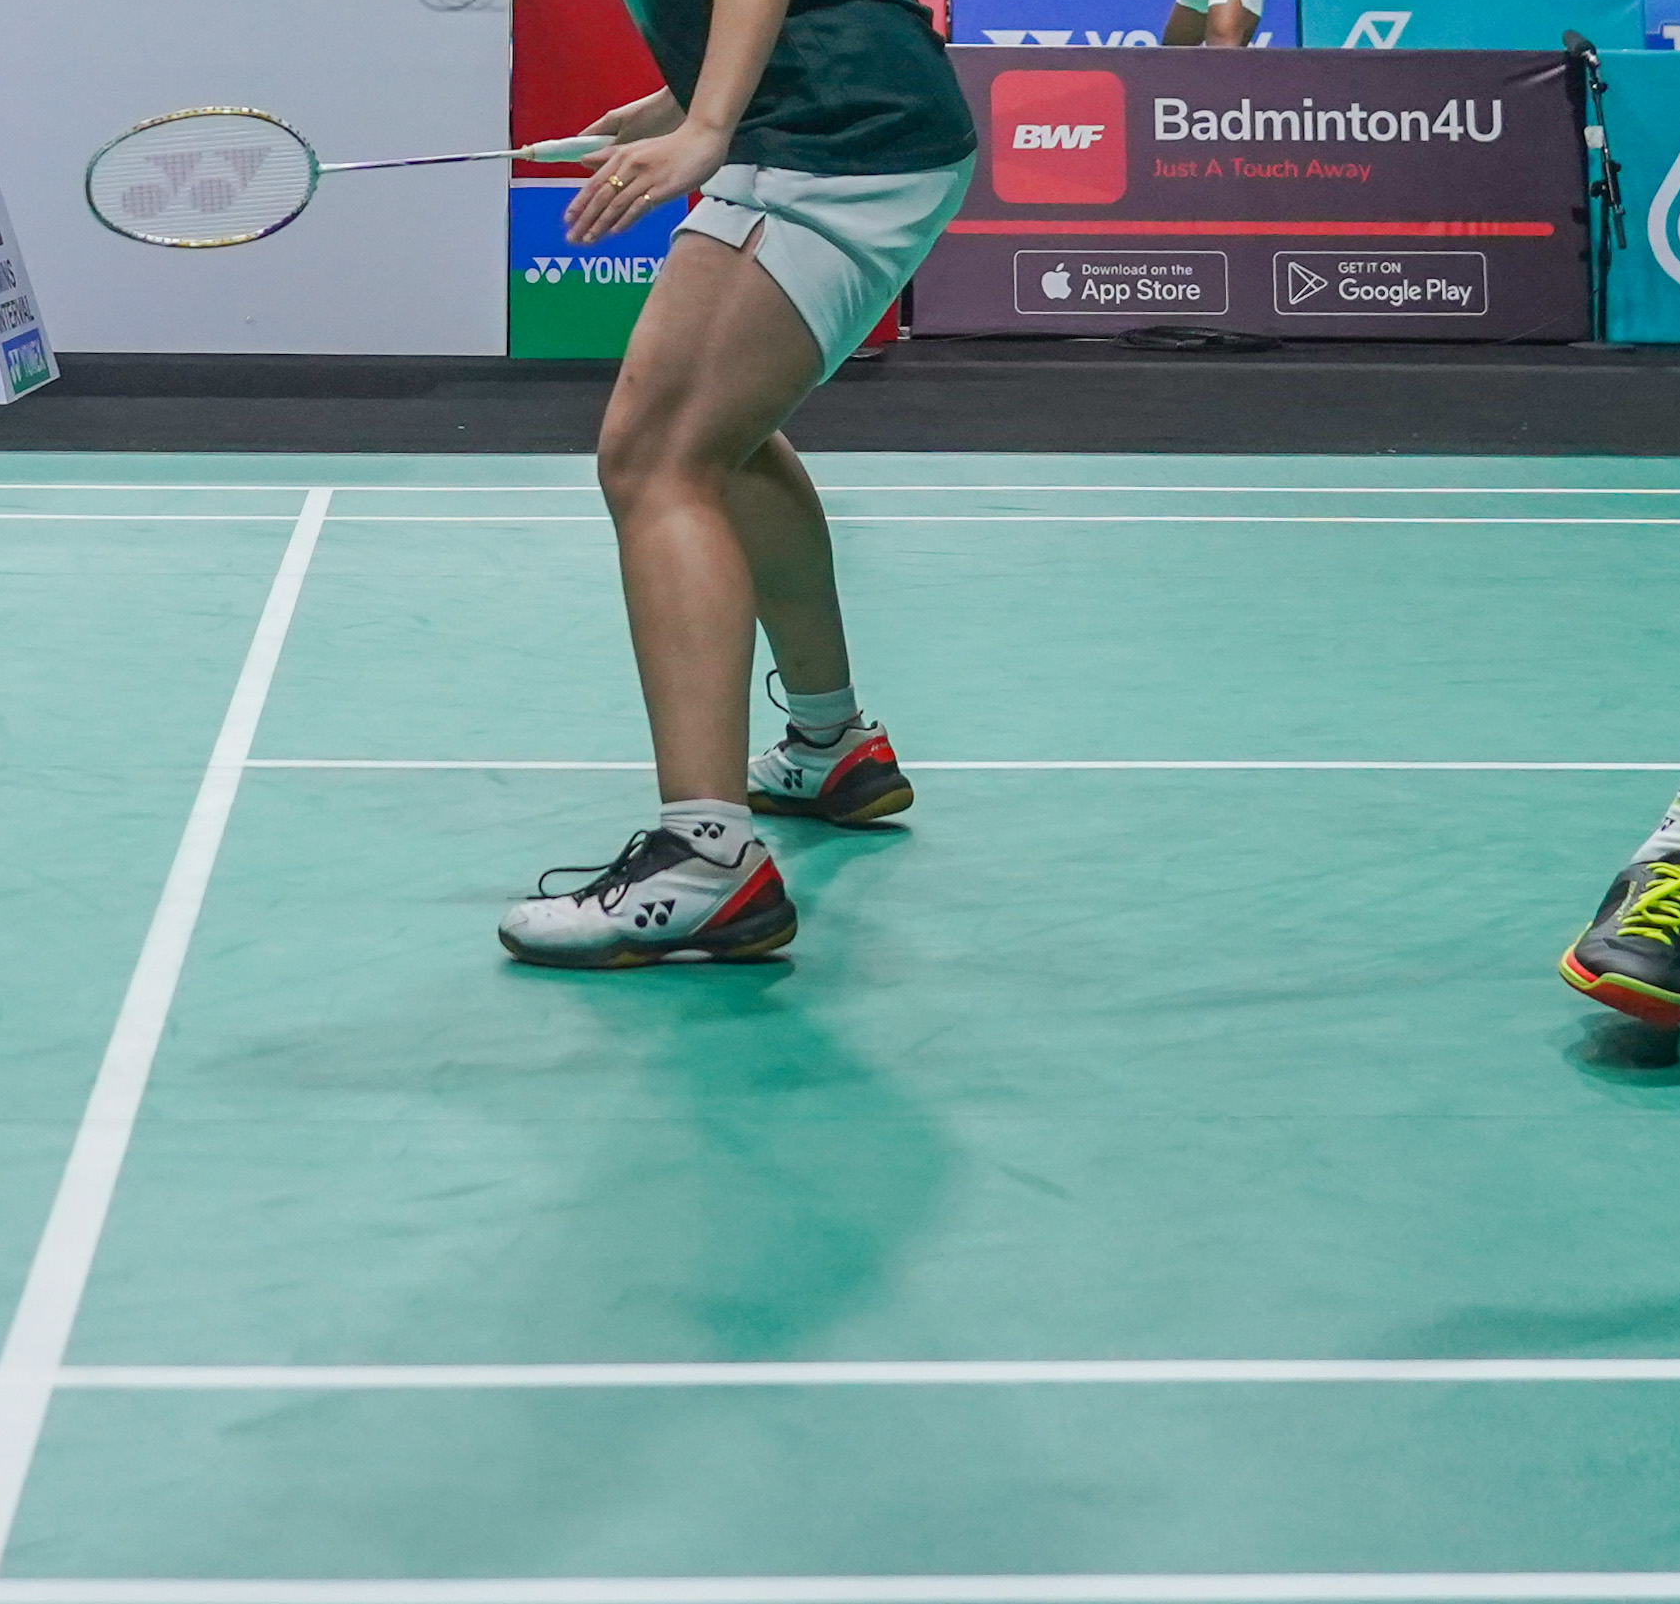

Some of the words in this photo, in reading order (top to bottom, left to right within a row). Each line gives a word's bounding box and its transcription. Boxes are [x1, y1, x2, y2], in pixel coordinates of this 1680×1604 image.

[1153, 97, 1504, 144] Badminton4U
[1012, 124, 1105, 151] BWF
[1152, 157, 1198, 180] Just
[1206, 158, 1223, 179] A
[1230, 157, 1300, 180] Touch
[1305, 158, 1373, 183] Away
[580, 256, 664, 284] YONEX
[1081, 262, 1142, 277] Download
[1148, 265, 1163, 277] on
[1168, 263, 1194, 277] the
[1338, 261, 1361, 274] GET
[1364, 262, 1376, 274] IT
[1379, 262, 1402, 275] ON
[1081, 279, 1124, 306] App
[1129, 278, 1201, 302] Store
[1338, 278, 1419, 307] Google
[1426, 280, 1473, 307] Play
